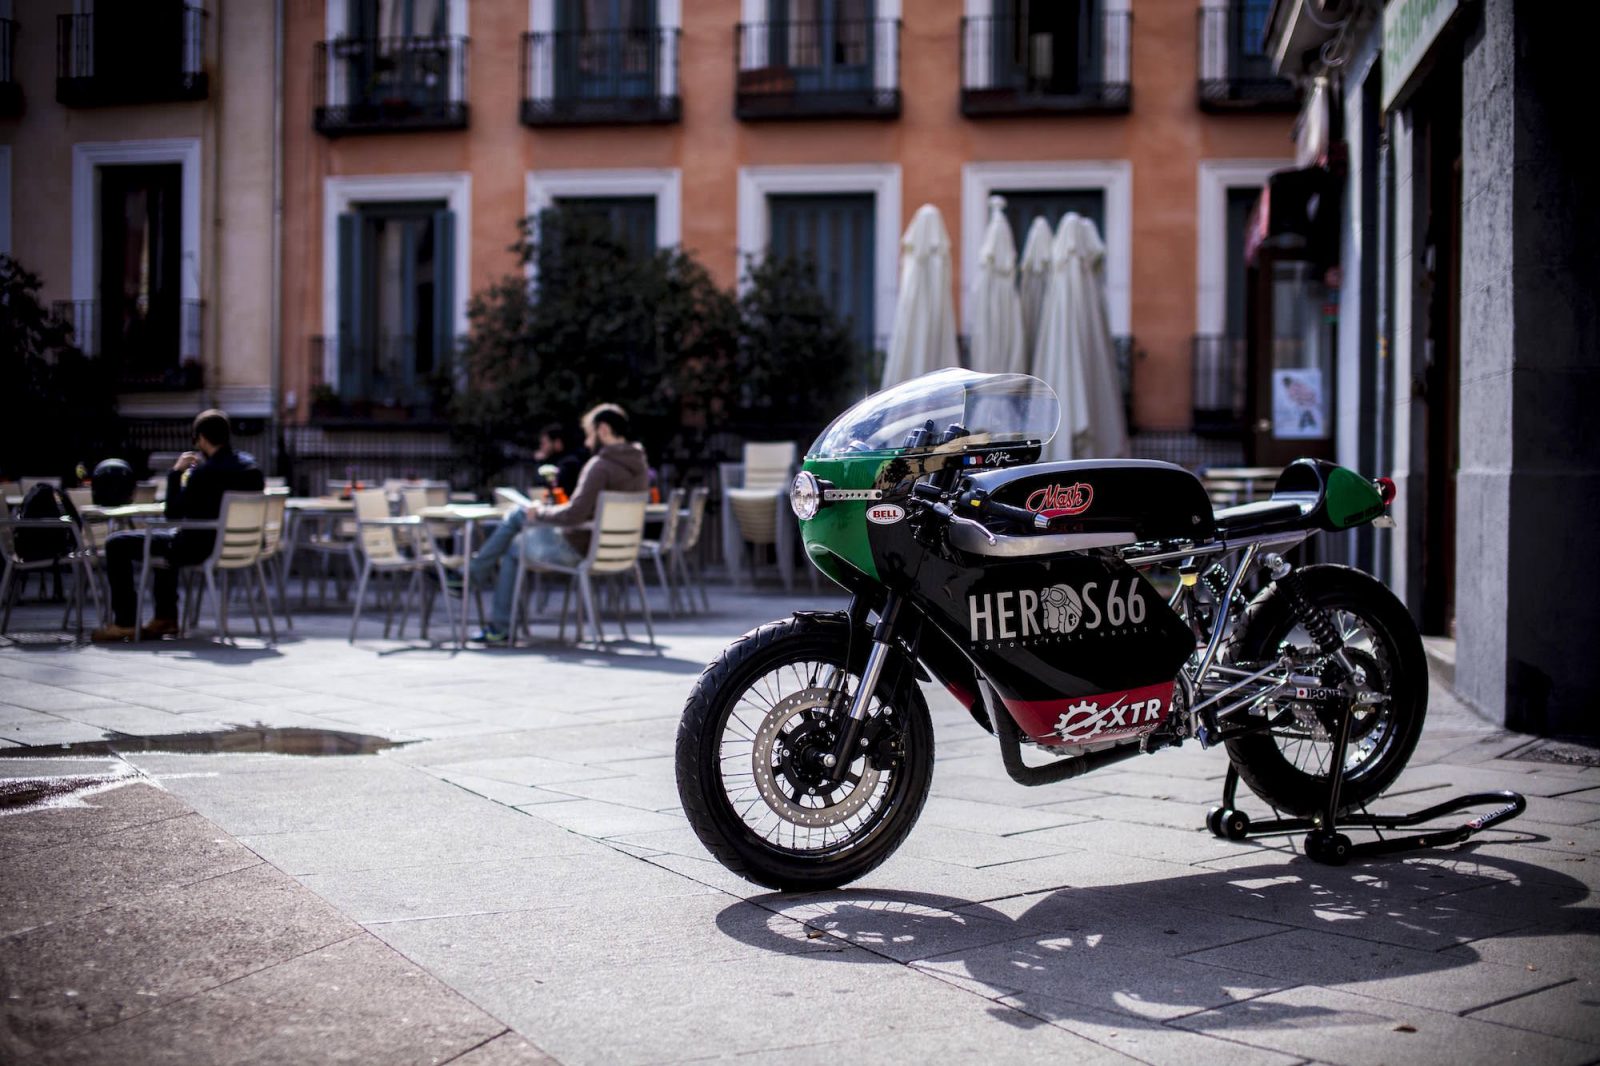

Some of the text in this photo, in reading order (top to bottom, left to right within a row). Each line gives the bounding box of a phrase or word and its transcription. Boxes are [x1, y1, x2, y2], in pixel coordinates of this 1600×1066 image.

[1028, 481, 1092, 514] Mash
[873, 510, 898, 518] BELL
[1107, 577, 1146, 626] 66
[1106, 698, 1162, 728] XTR
